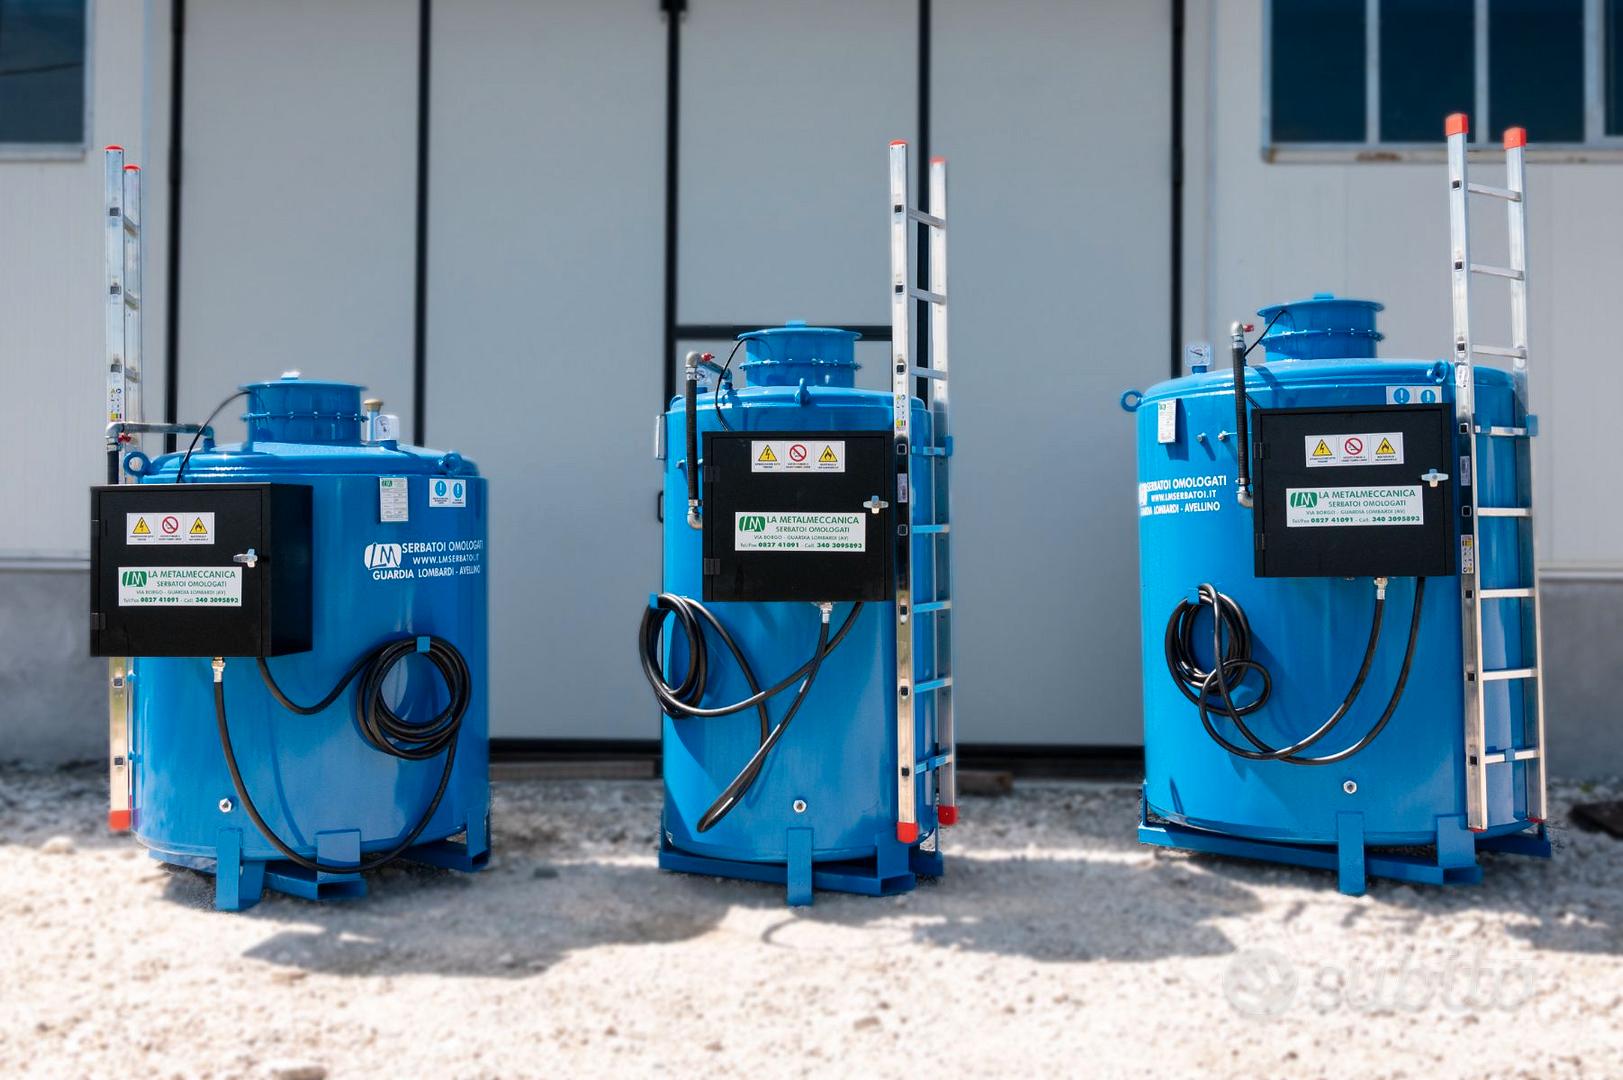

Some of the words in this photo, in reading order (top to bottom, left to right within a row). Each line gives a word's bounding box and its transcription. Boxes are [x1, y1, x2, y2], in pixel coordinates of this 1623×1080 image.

[1173, 476, 1226, 489] OMOLOGATI
[1332, 489, 1416, 498] METALMECCANICA
[1185, 502, 1220, 512] AVELLINO
[402, 542, 446, 554] SERBATOI
[449, 540, 483, 551] OMOLOGATI
[373, 569, 414, 580] GUARDIA
[418, 567, 454, 578] LOMBARDI
